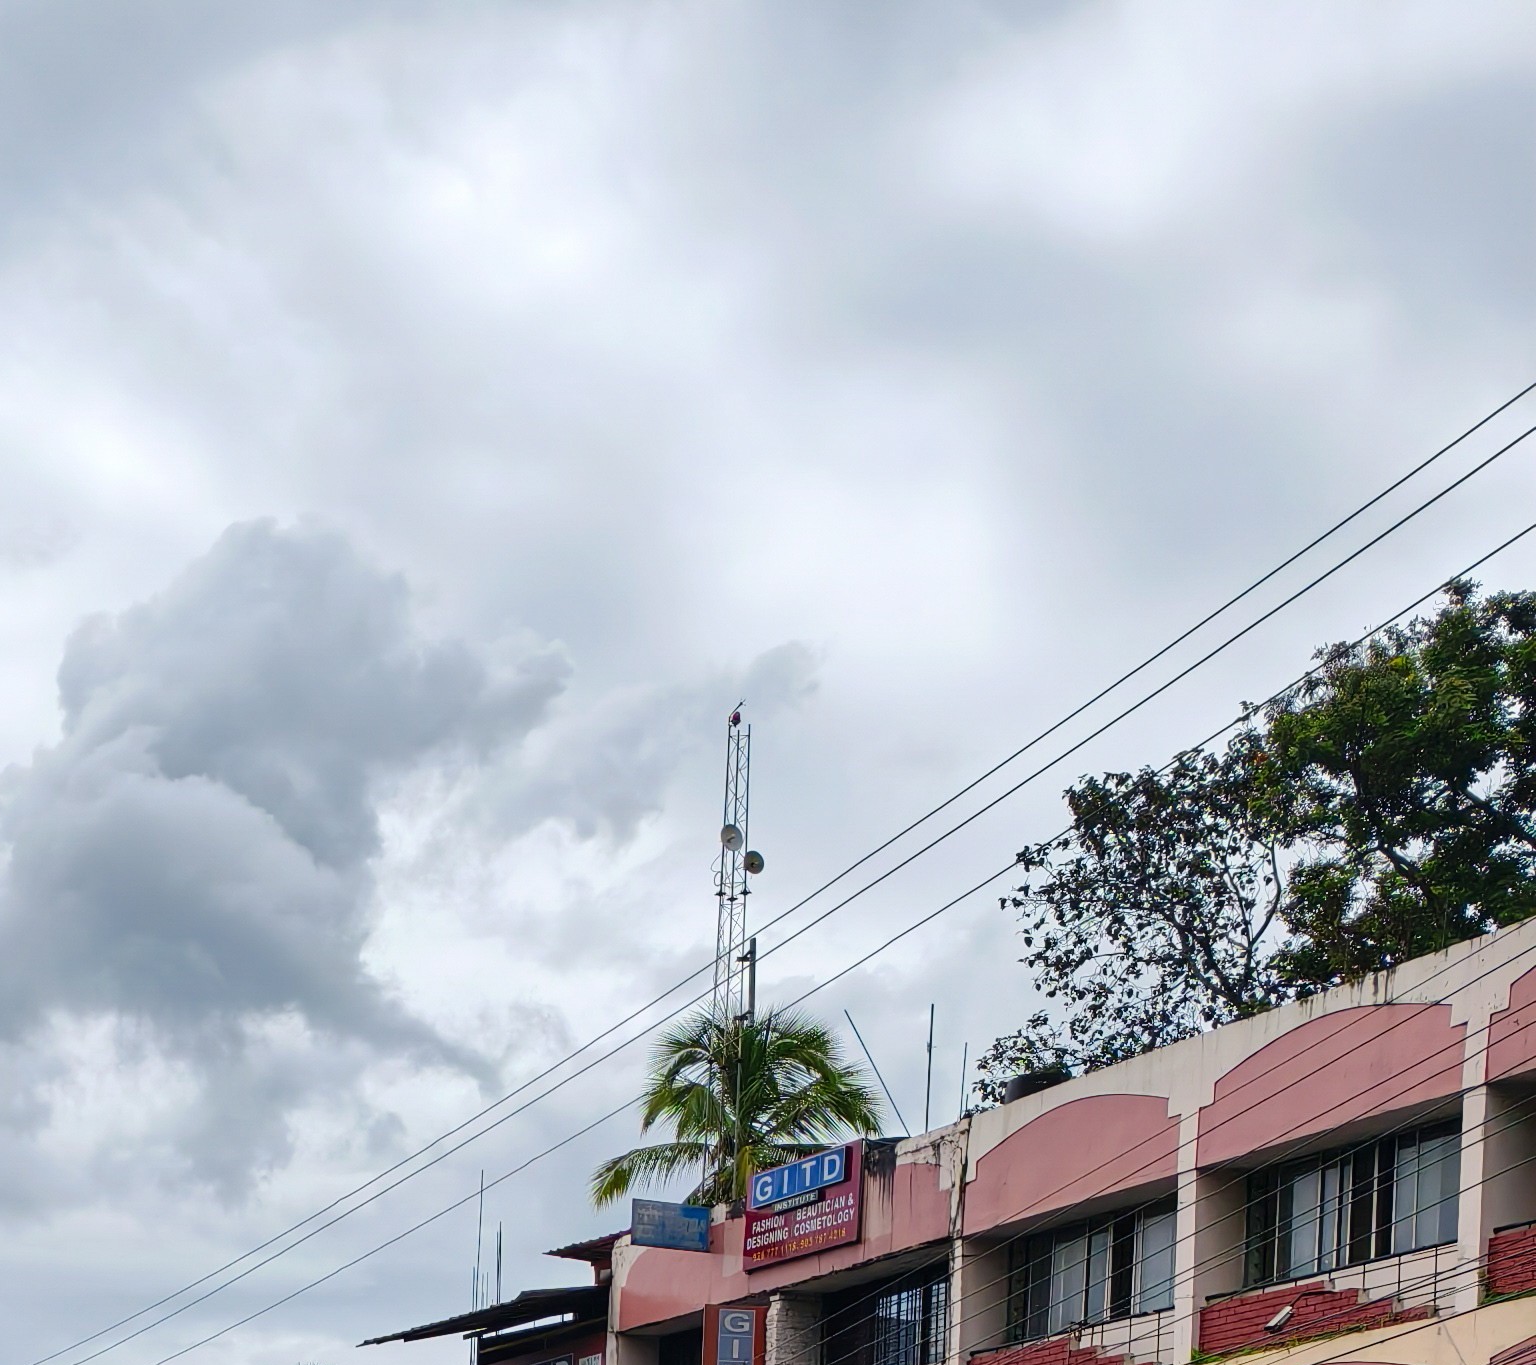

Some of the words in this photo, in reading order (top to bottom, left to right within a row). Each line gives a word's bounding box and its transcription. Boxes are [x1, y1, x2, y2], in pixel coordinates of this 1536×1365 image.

[755, 1154, 840, 1202] GITD
[774, 1192, 817, 1212] INSTITUTE
[796, 1196, 845, 1221] BEAUTICIAN
[847, 1192, 854, 1206] &
[752, 1214, 785, 1234] FASHION
[794, 1207, 855, 1236] COSMETOLOGY
[746, 1227, 789, 1250] DESIGNING
